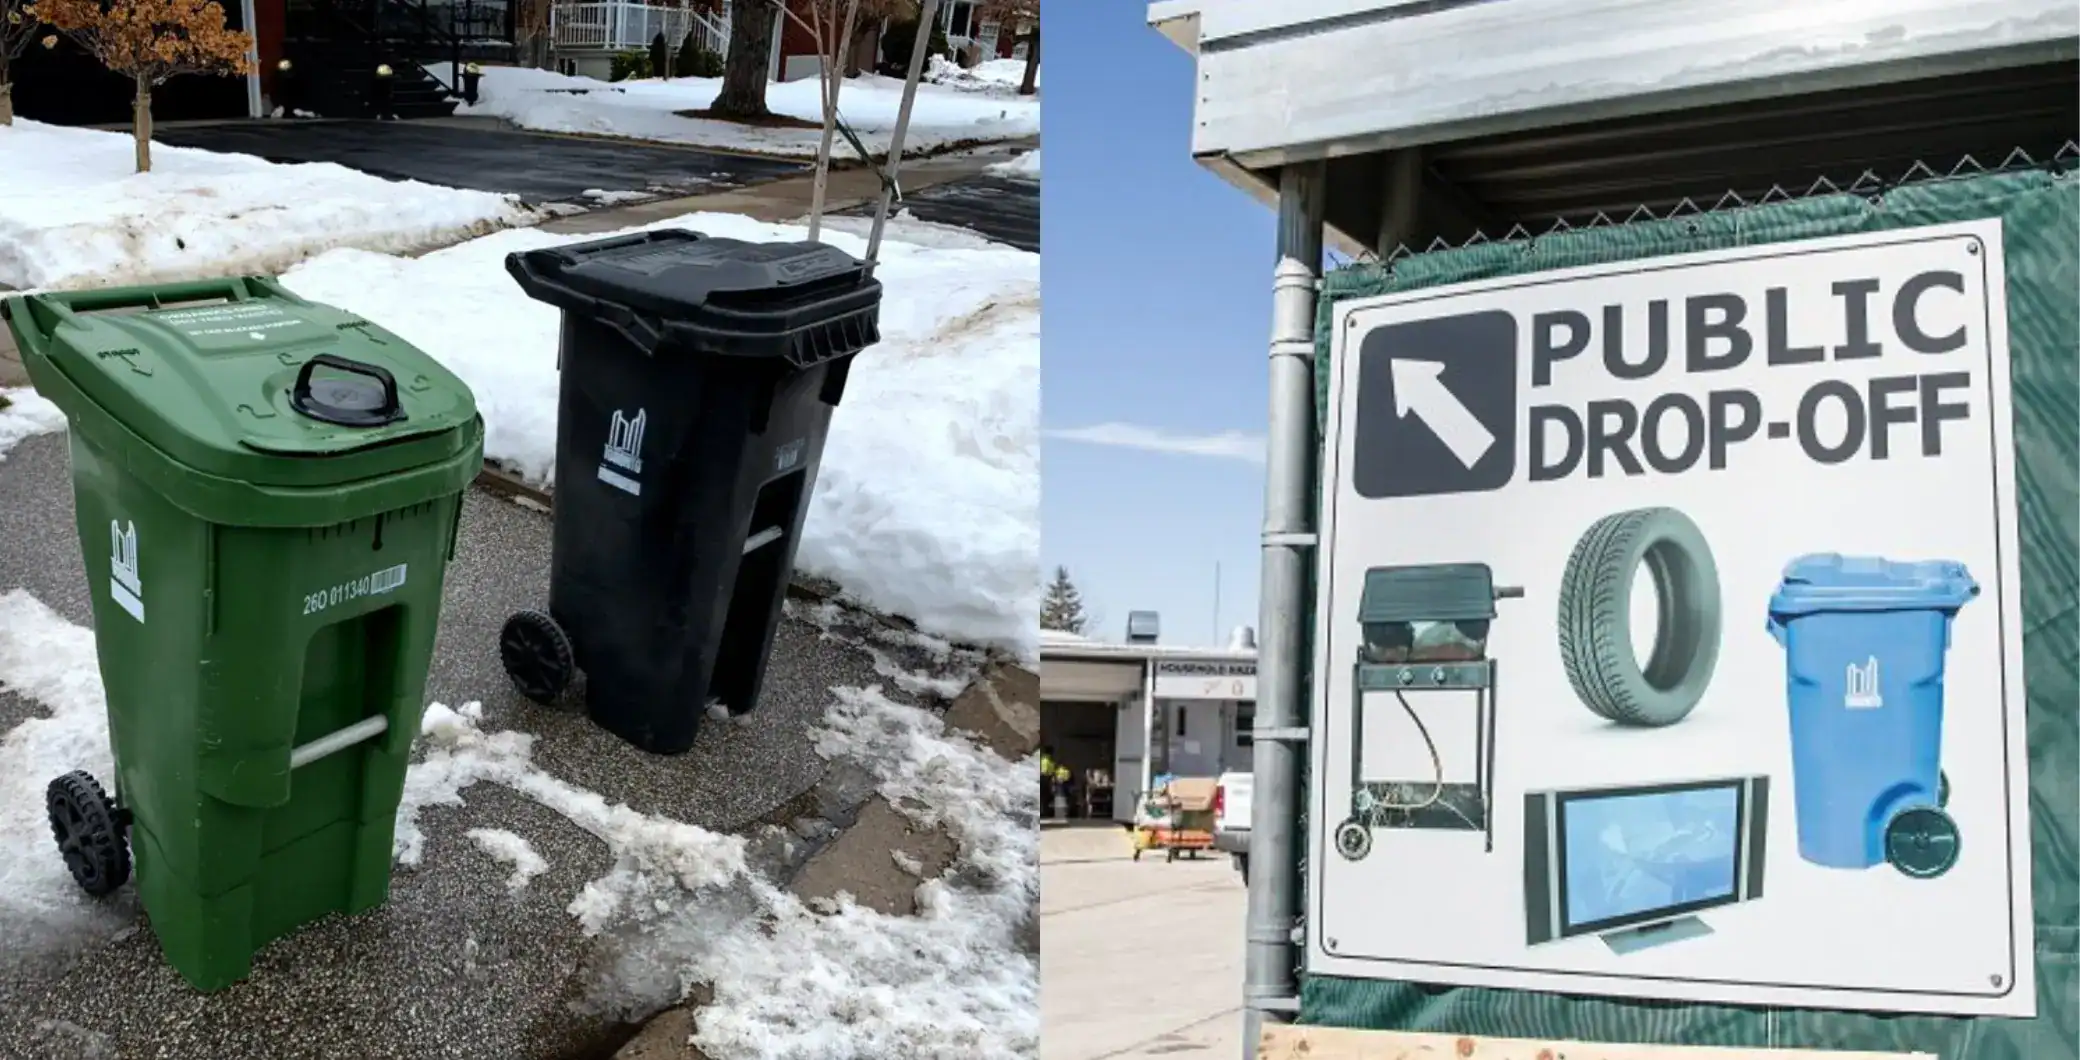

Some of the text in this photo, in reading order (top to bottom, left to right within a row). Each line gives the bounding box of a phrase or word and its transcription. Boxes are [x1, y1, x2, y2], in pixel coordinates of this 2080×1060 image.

[1531, 270, 1967, 388] PUBLIC
[1529, 371, 1970, 482] DROP-OFF
[330, 576, 370, 606] 011340
